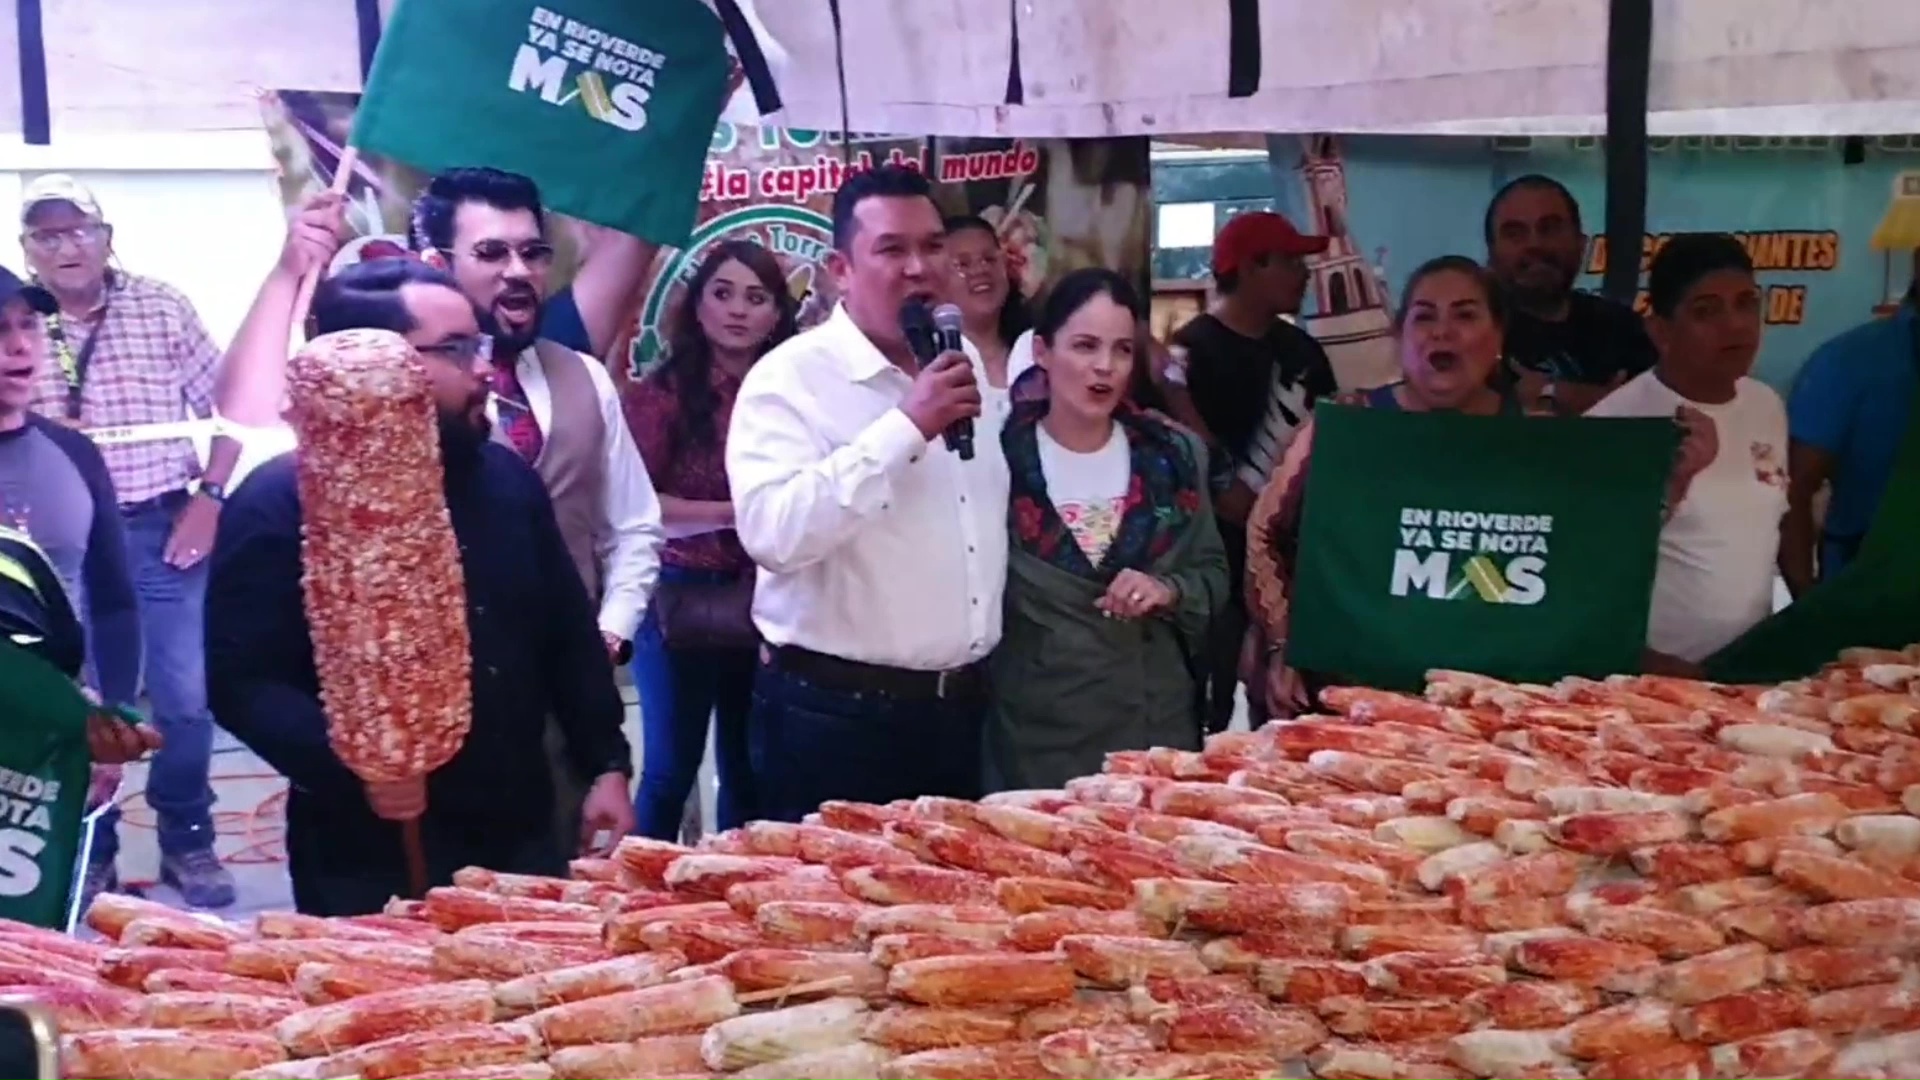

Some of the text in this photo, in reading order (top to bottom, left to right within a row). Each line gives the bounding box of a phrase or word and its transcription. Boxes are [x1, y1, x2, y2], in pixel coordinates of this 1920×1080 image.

[528, 24, 656, 88] YA SE NOTA
[531, 6, 666, 70] EN RIOVERDE
[939, 138, 1039, 183] mundo
[1767, 286, 1804, 323] DE
[1400, 507, 1553, 533] EN RIOVERDE
[1400, 526, 1549, 554] YA SE NOTA
